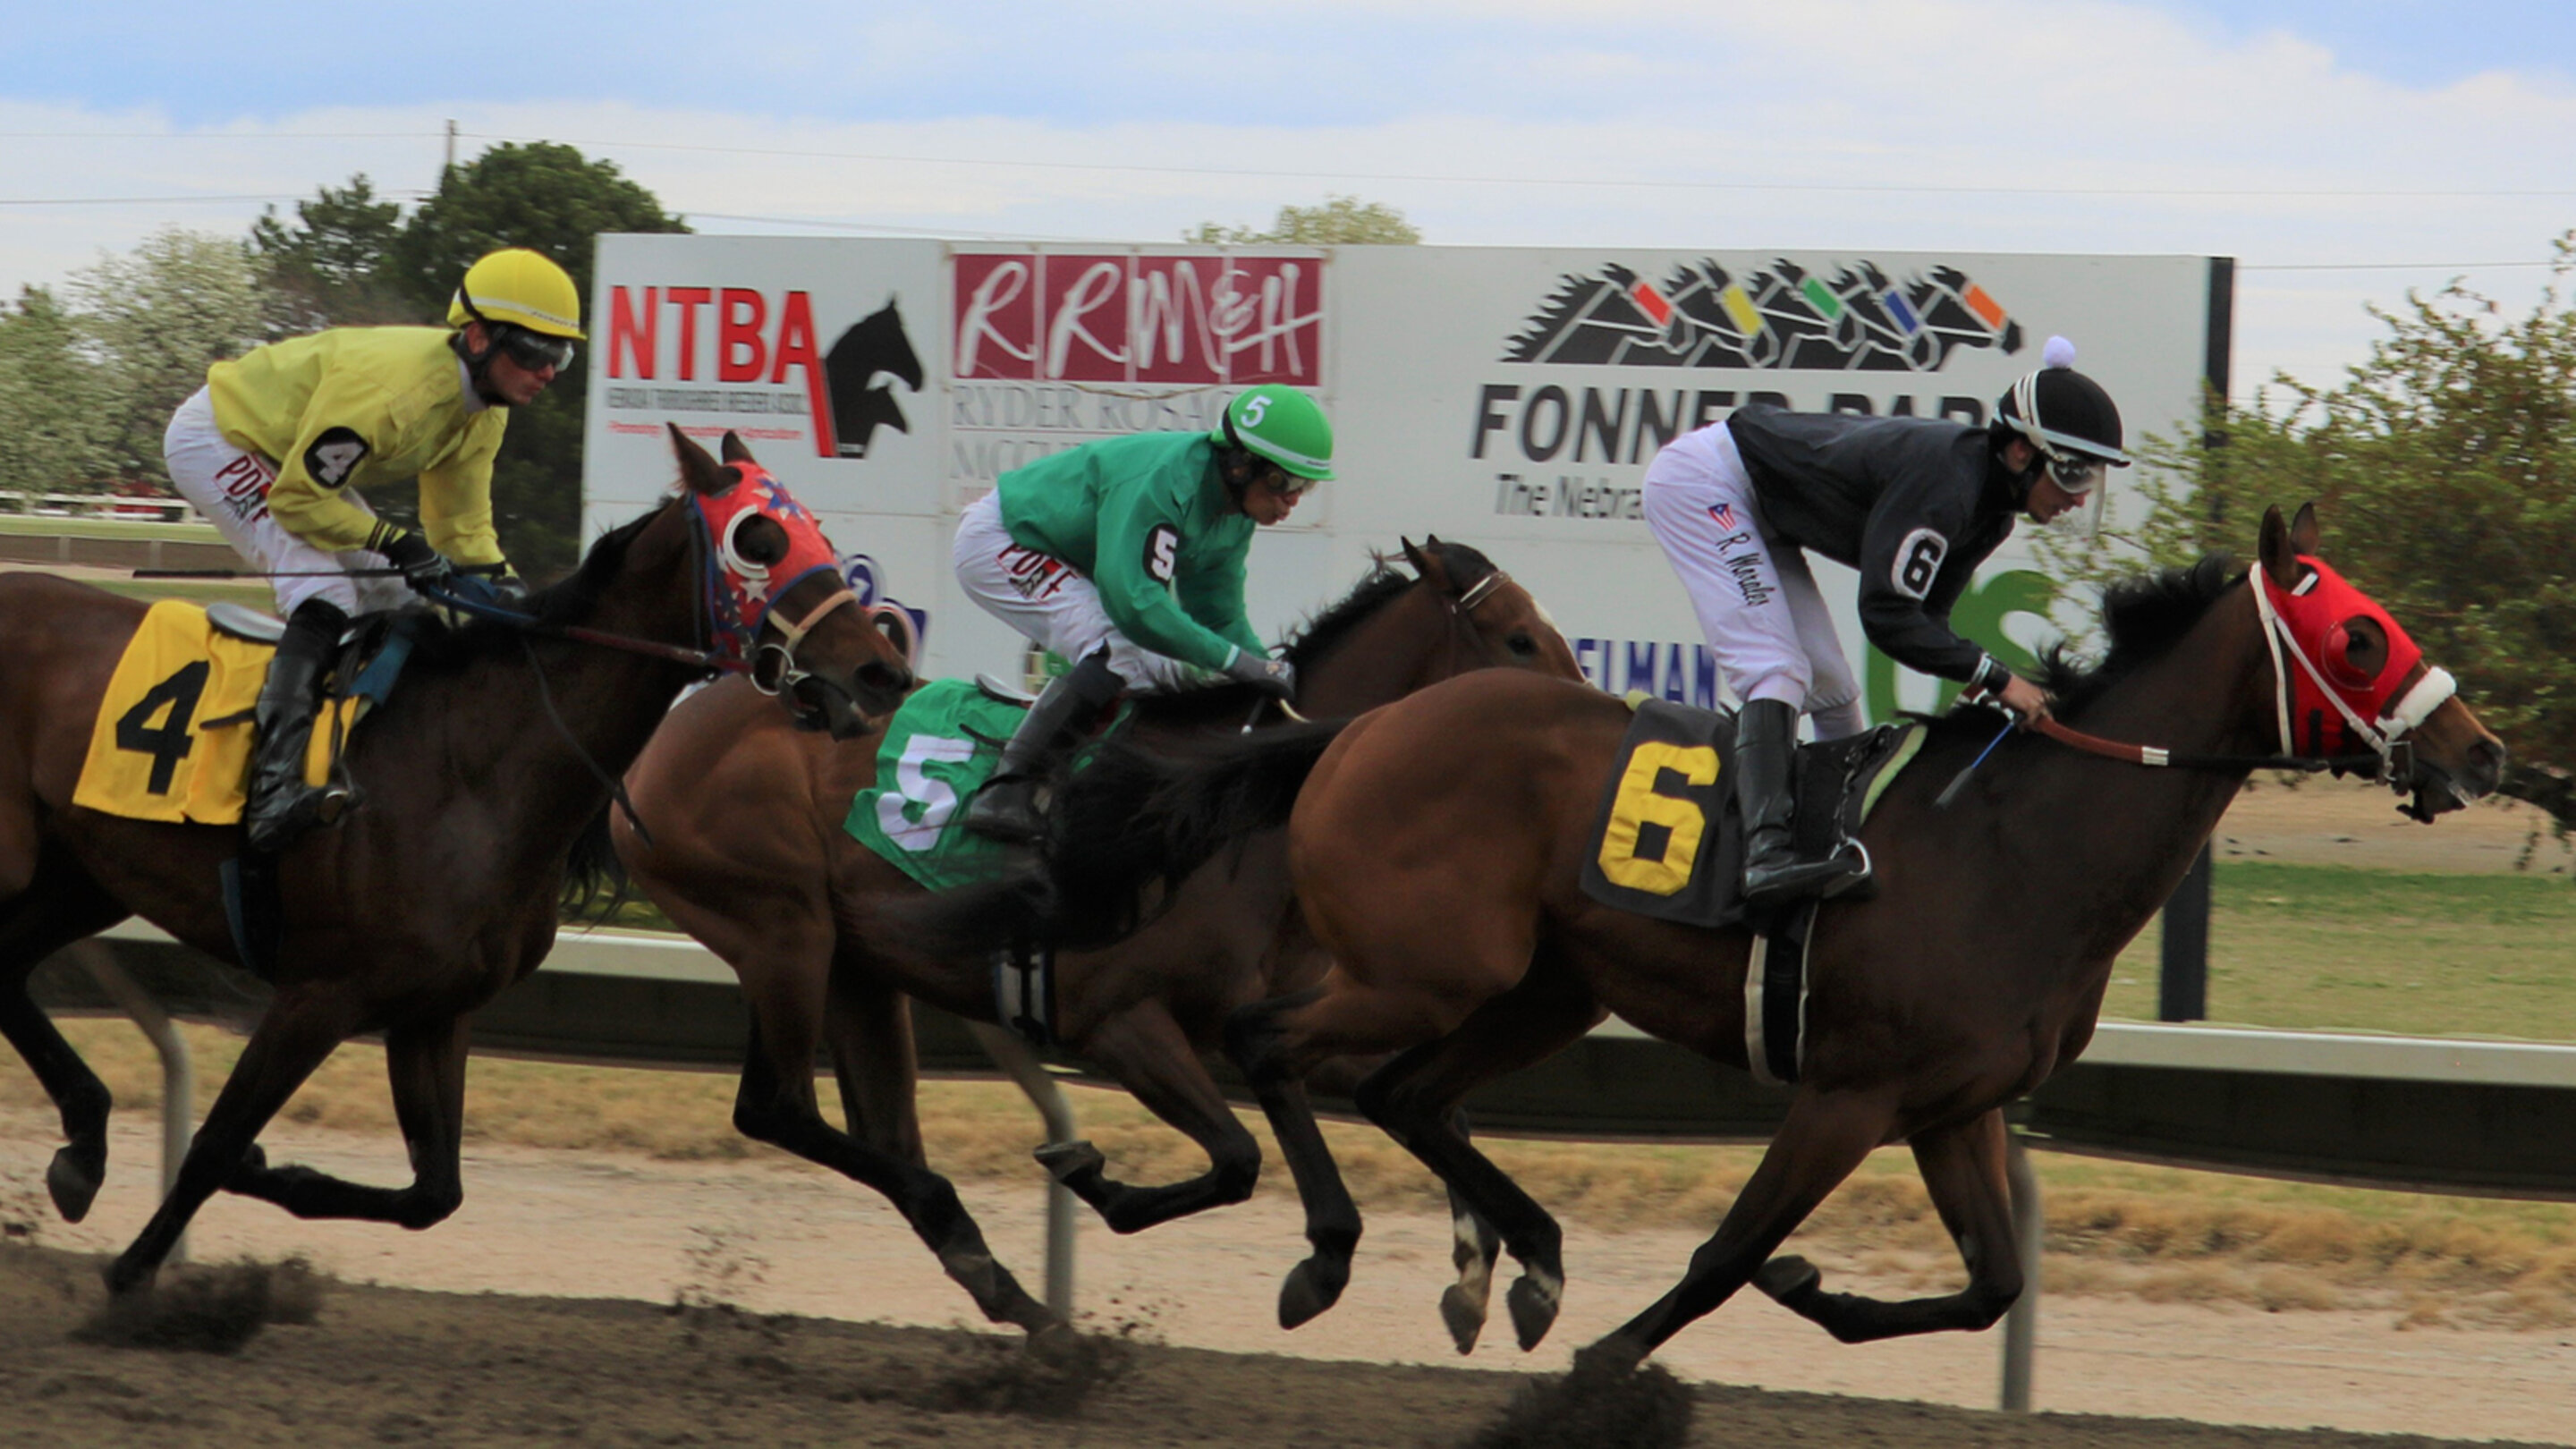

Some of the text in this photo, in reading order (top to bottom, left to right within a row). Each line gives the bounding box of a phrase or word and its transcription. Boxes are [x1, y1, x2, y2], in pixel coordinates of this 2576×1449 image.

[606, 285, 837, 457] NTBA
[952, 385, 1231, 433] RYDER ROSAC
[1240, 395, 1273, 428] 5
[1470, 384, 1790, 464] FONNE
[1496, 474, 1641, 521] The Nebra
[1151, 528, 1178, 581] 5
[1716, 532, 1775, 606] R. Morales
[1902, 538, 1943, 587] 6
[1571, 638, 1716, 709] ELMAN
[116, 660, 209, 794] 4
[876, 734, 975, 852] 5
[1597, 741, 1721, 896] 6
